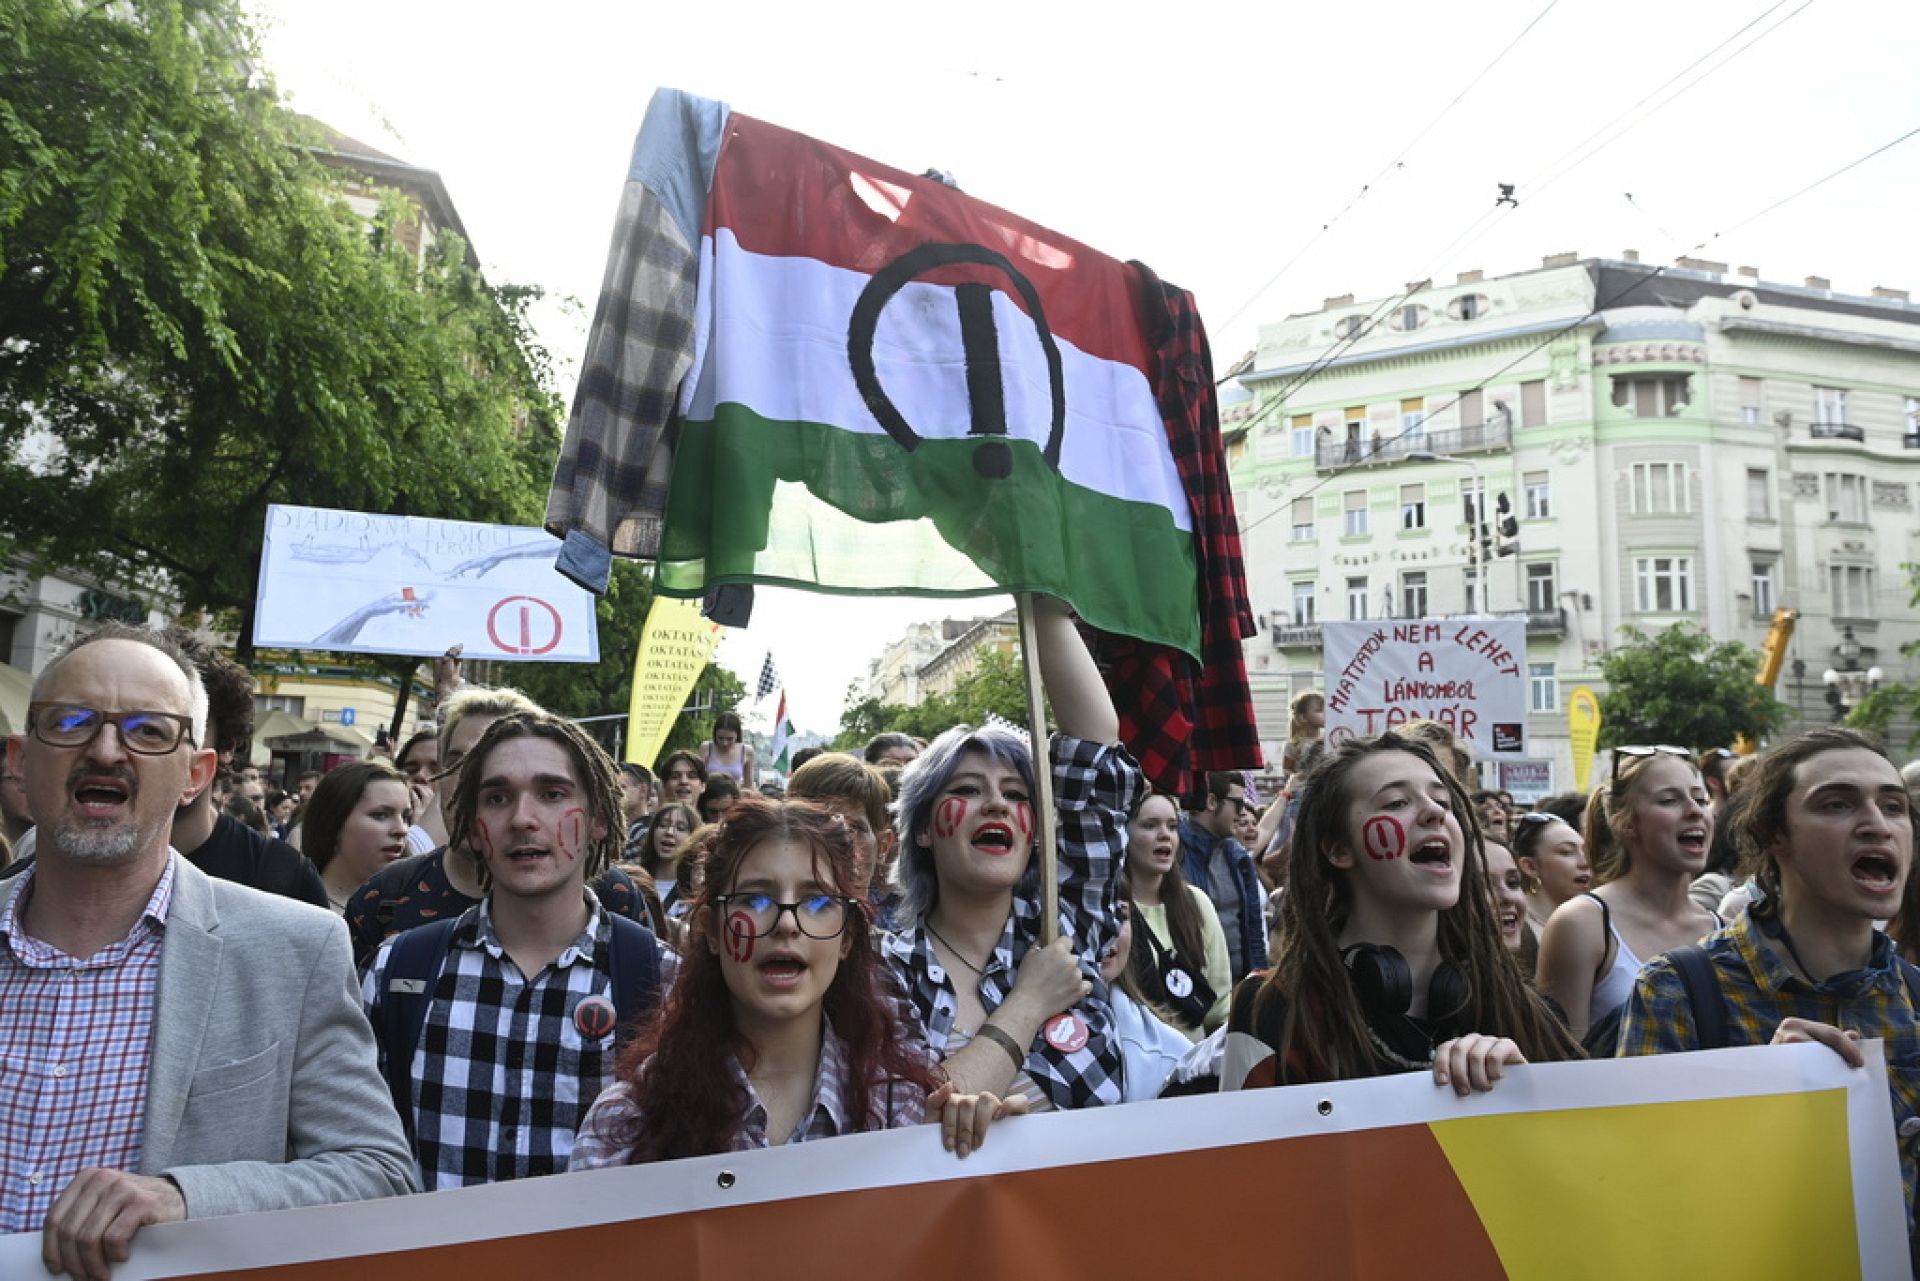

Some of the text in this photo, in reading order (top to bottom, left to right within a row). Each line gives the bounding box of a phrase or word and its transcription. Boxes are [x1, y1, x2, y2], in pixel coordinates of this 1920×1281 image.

[1328, 624, 1519, 714] MIATTATOK NEM LEHET
[1418, 651, 1434, 673] A
